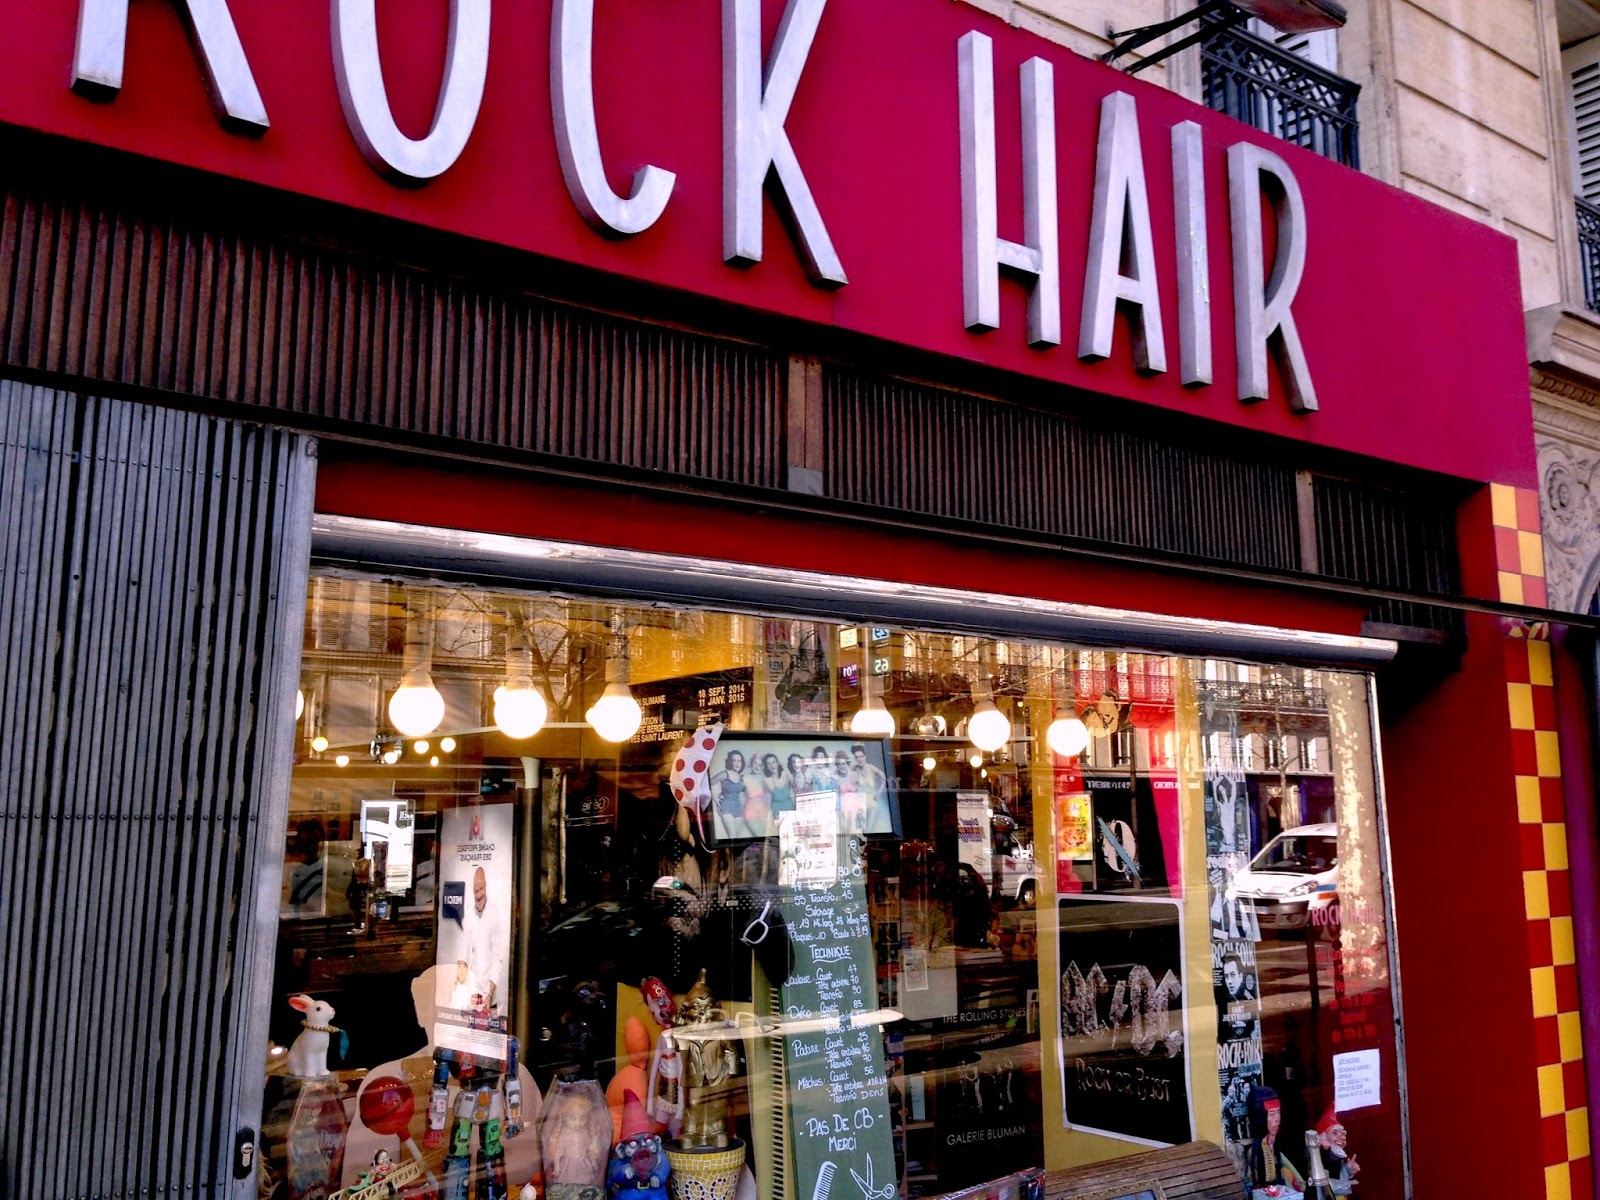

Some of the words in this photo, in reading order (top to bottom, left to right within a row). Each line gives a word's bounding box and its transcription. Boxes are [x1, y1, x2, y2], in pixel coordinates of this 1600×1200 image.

[70, 0, 848, 290] CK
[957, 30, 1319, 413] HAIR
[642, 695, 666, 706] SLIMANE
[699, 698, 706, 707] 11
[708, 695, 725, 706] JANV.
[729, 692, 745, 703] 2015
[708, 687, 725, 697] SEPT.
[729, 684, 745, 694] 2014
[642, 733, 657, 743] SAINT
[658, 730, 684, 741] LAURENT
[1312, 904, 1343, 926] ROCK
[943, 1013, 958, 1024] THE
[960, 1009, 998, 1022] ROLLING
[1000, 1007, 1026, 1019] STONES
[1076, 1057, 1112, 1091] ROCK
[805, 1117, 830, 1137] PAS
[832, 1113, 851, 1133] DE
[853, 1107, 875, 1129] CB
[828, 1131, 857, 1152] MERCI
[946, 1129, 985, 1146] GALERIE
[986, 1124, 1026, 1140] BLUMAN
